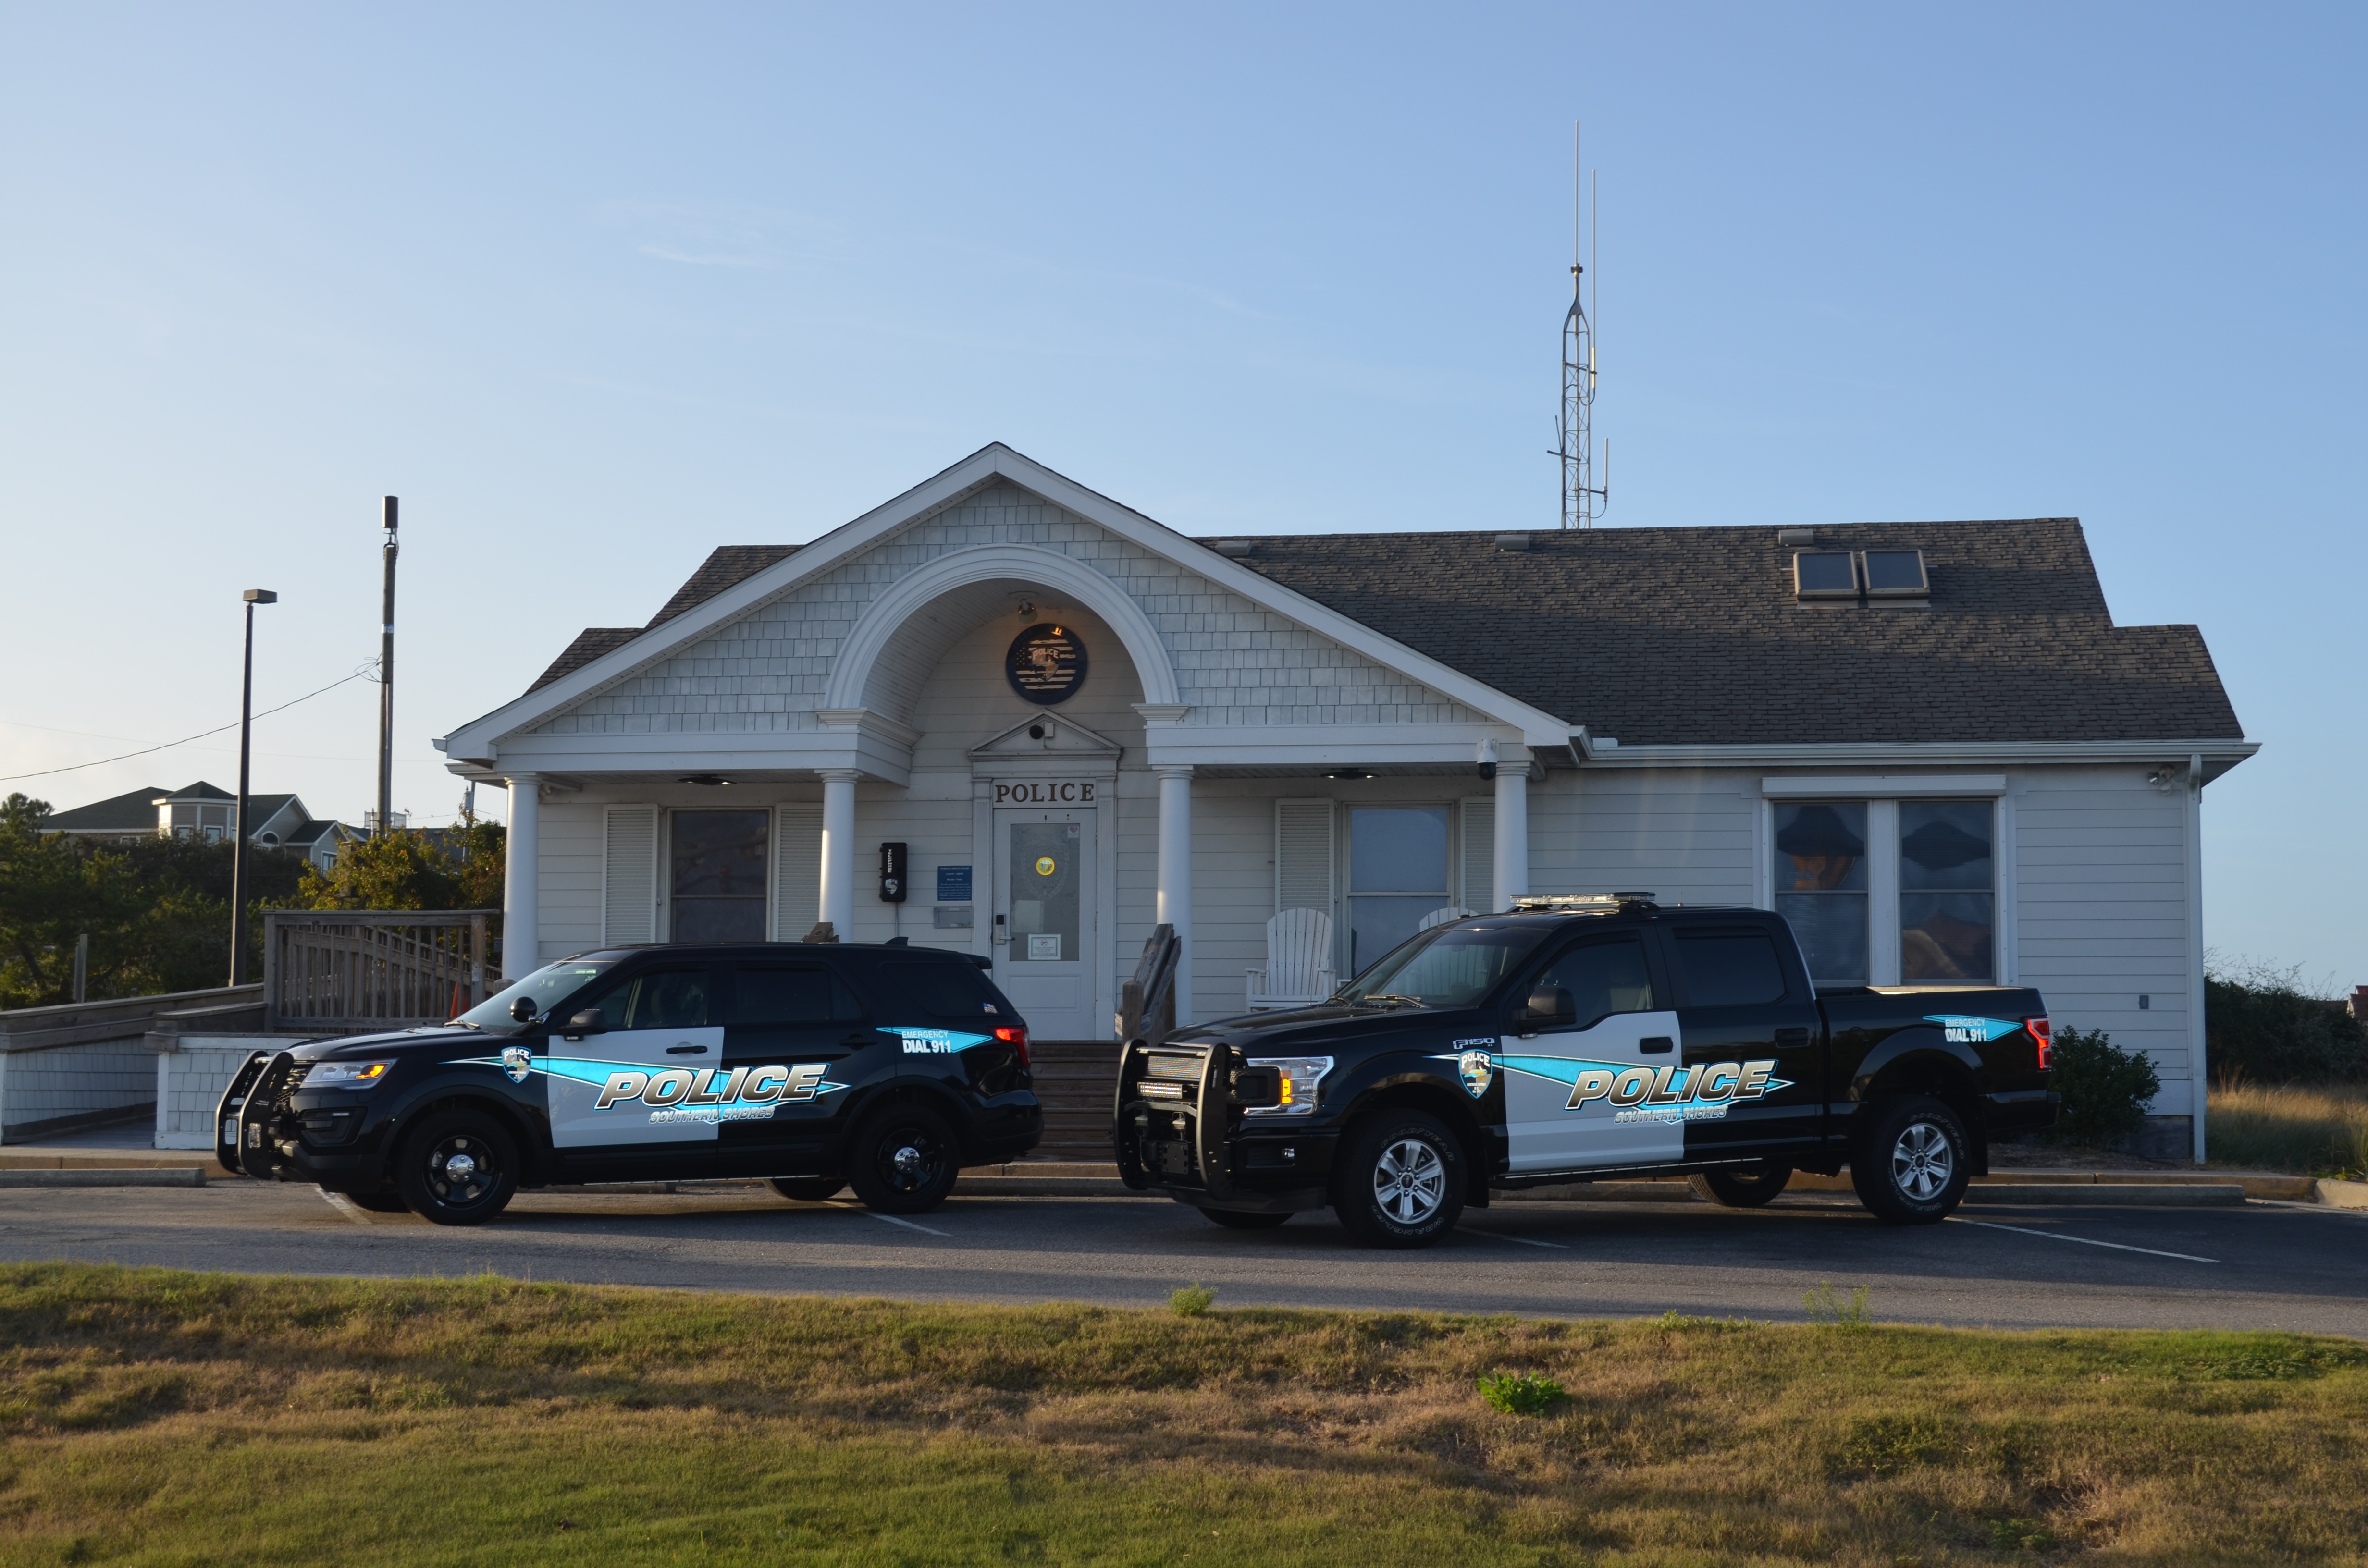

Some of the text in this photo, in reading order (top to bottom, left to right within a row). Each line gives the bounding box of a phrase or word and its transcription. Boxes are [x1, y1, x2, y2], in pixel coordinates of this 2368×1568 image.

[1032, 648, 1060, 661] POLICE
[995, 783, 1094, 803] POLICE
[1945, 1019, 1985, 1027] EMERGENCY
[901, 1030, 948, 1039] EMERGENCY
[1945, 1028, 1987, 1042] DIAL 911
[504, 1048, 530, 1061] POLICE
[902, 1040, 951, 1053] DIAL 911
[1461, 1052, 1491, 1069] POLICE
[593, 1063, 831, 1111] POLICE
[1563, 1059, 1778, 1112] POLICE
[649, 1106, 775, 1124] SOUTHERN SHORES
[1614, 1105, 1728, 1125] SOUTHERN SHORES
[1381, 1127, 1455, 1162] GOODYEAR
[1909, 1112, 1964, 1160] GOODYEAR
[1888, 1167, 1942, 1212] WRANGLER
[1371, 1205, 1444, 1235] WRANGLER
